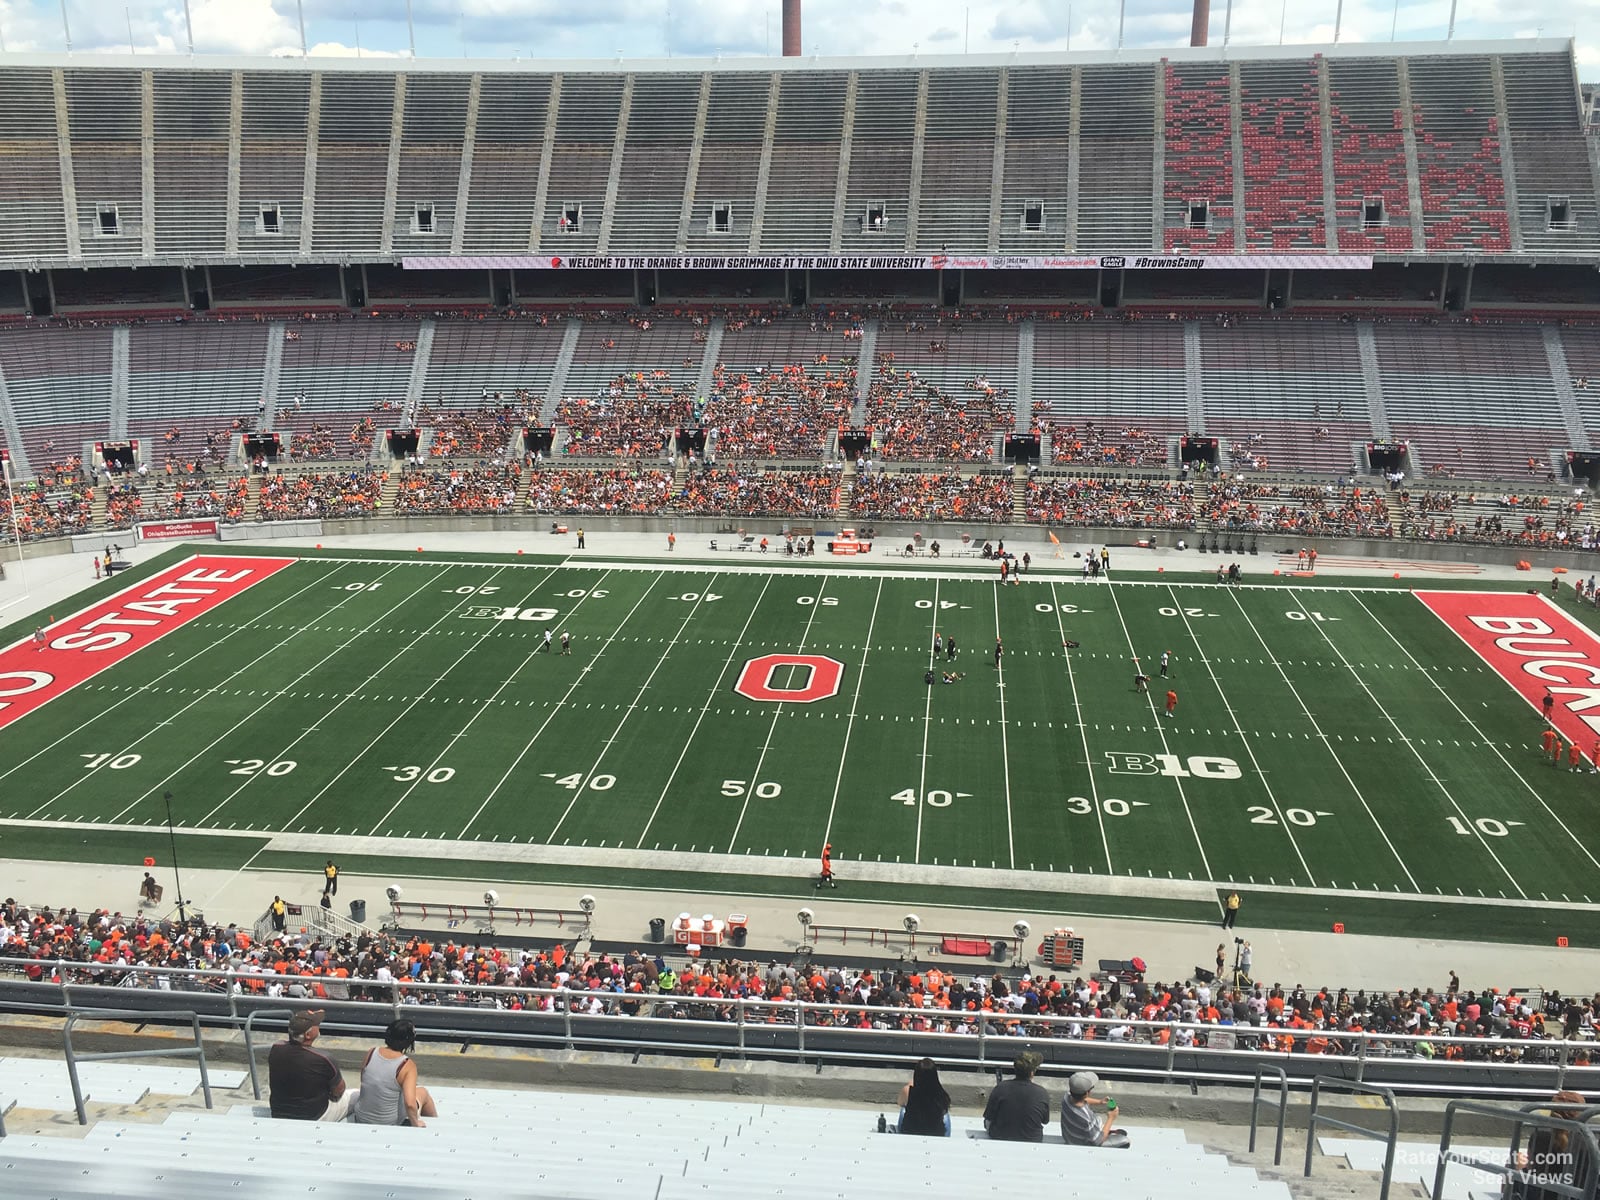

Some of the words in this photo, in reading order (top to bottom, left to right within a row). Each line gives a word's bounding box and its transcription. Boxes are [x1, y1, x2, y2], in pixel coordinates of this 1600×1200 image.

[569, 257, 612, 268] WELCOME
[615, 257, 626, 268] TO
[629, 257, 645, 268] THE
[647, 257, 682, 268] ORANGE
[684, 257, 691, 268] &
[693, 257, 725, 268] BROWN
[727, 257, 781, 268] SCRIMMAGE
[784, 257, 795, 268] AT
[798, 257, 814, 268] THE
[816, 257, 839, 268] OHIO
[840, 257, 868, 268] STATE
[870, 257, 926, 268] UNIVERSITY
[1135, 257, 1205, 269] #BrownsCamp
[455, 585, 501, 595] 20
[567, 589, 610, 599] 30
[680, 592, 724, 602] 40
[796, 596, 839, 606] 50
[914, 599, 958, 610] 40
[1035, 603, 1078, 613] 30
[49, 568, 255, 652] STATE
[1158, 607, 1205, 617] 20
[84, 753, 142, 769] 10
[229, 759, 298, 776] 20
[393, 765, 456, 783] 30
[555, 773, 617, 791] 40
[720, 780, 782, 799] 50
[890, 788, 953, 807] 40
[1067, 797, 1130, 816] 30
[1247, 806, 1316, 826] 20
[1445, 816, 1509, 837] 10
[677, 931, 688, 941] G
